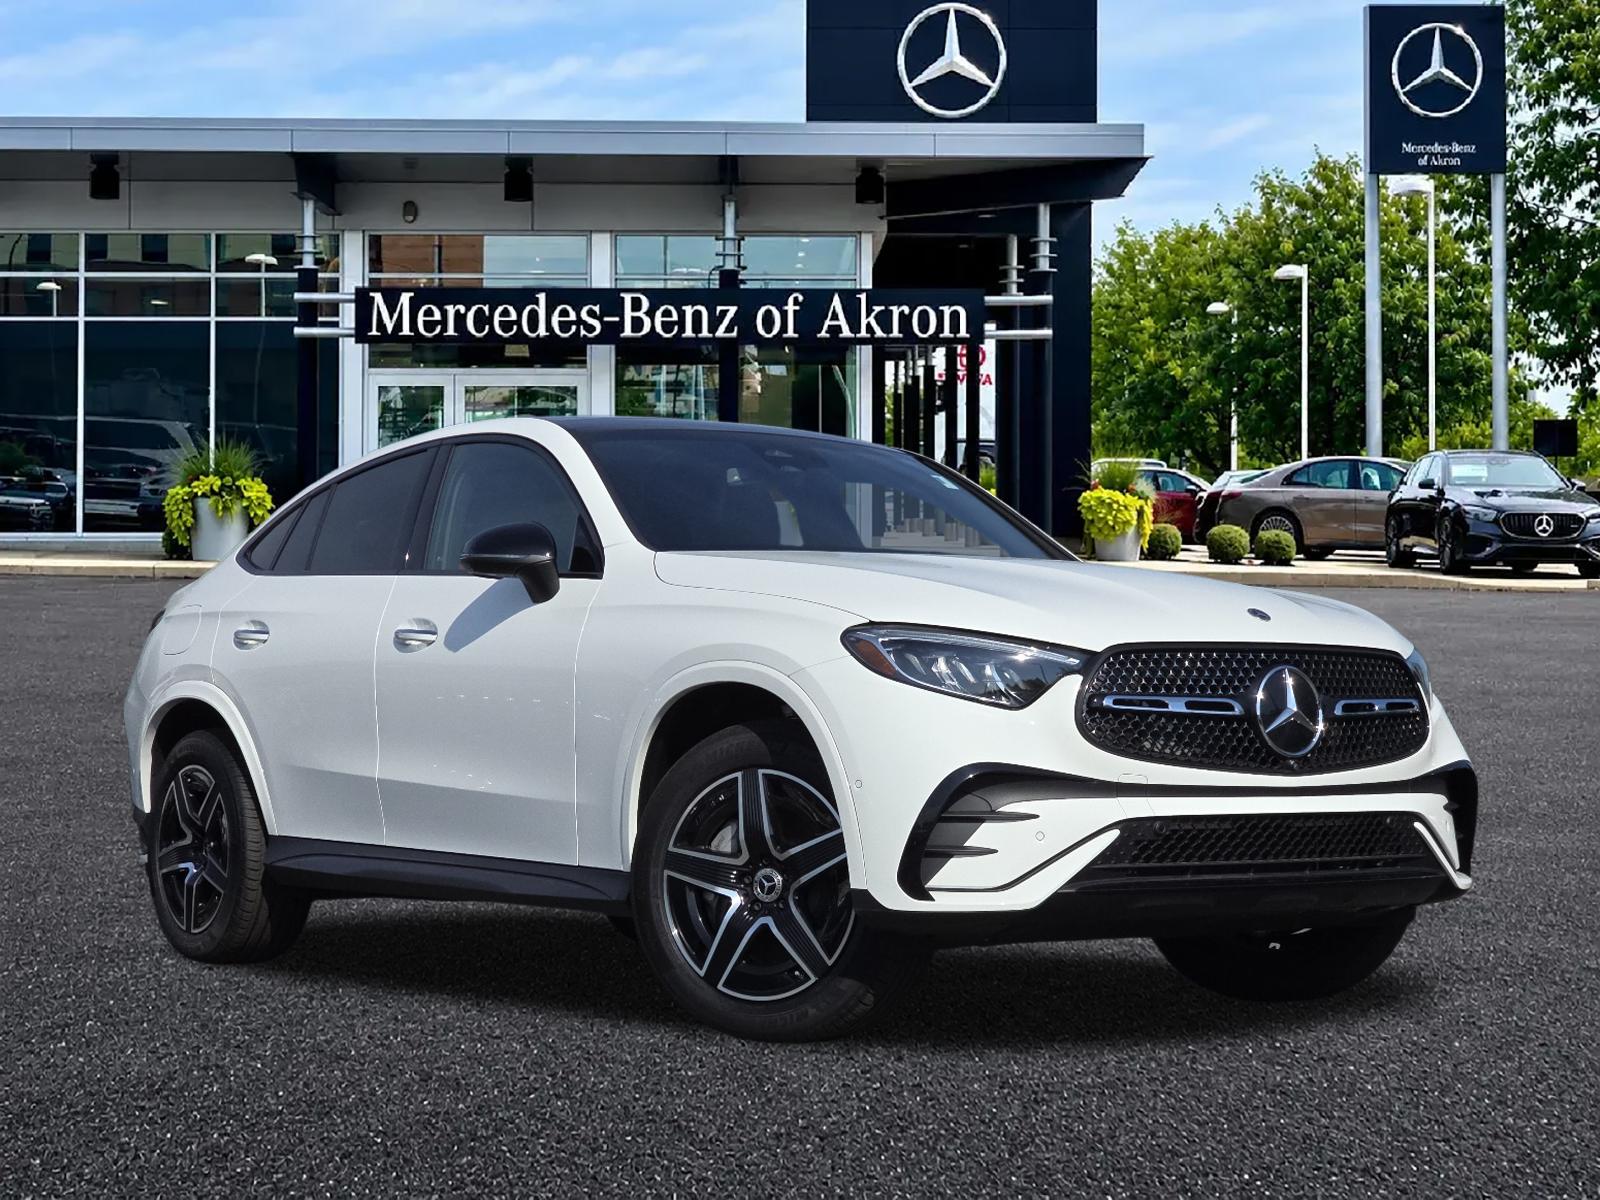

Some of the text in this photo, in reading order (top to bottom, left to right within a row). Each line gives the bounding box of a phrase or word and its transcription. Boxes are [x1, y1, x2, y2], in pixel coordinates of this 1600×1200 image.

[1401, 141, 1476, 153] Mercedes-Benz
[1418, 155, 1460, 165] of Akron
[368, 292, 970, 338] Mercedes-Benz of Akron
